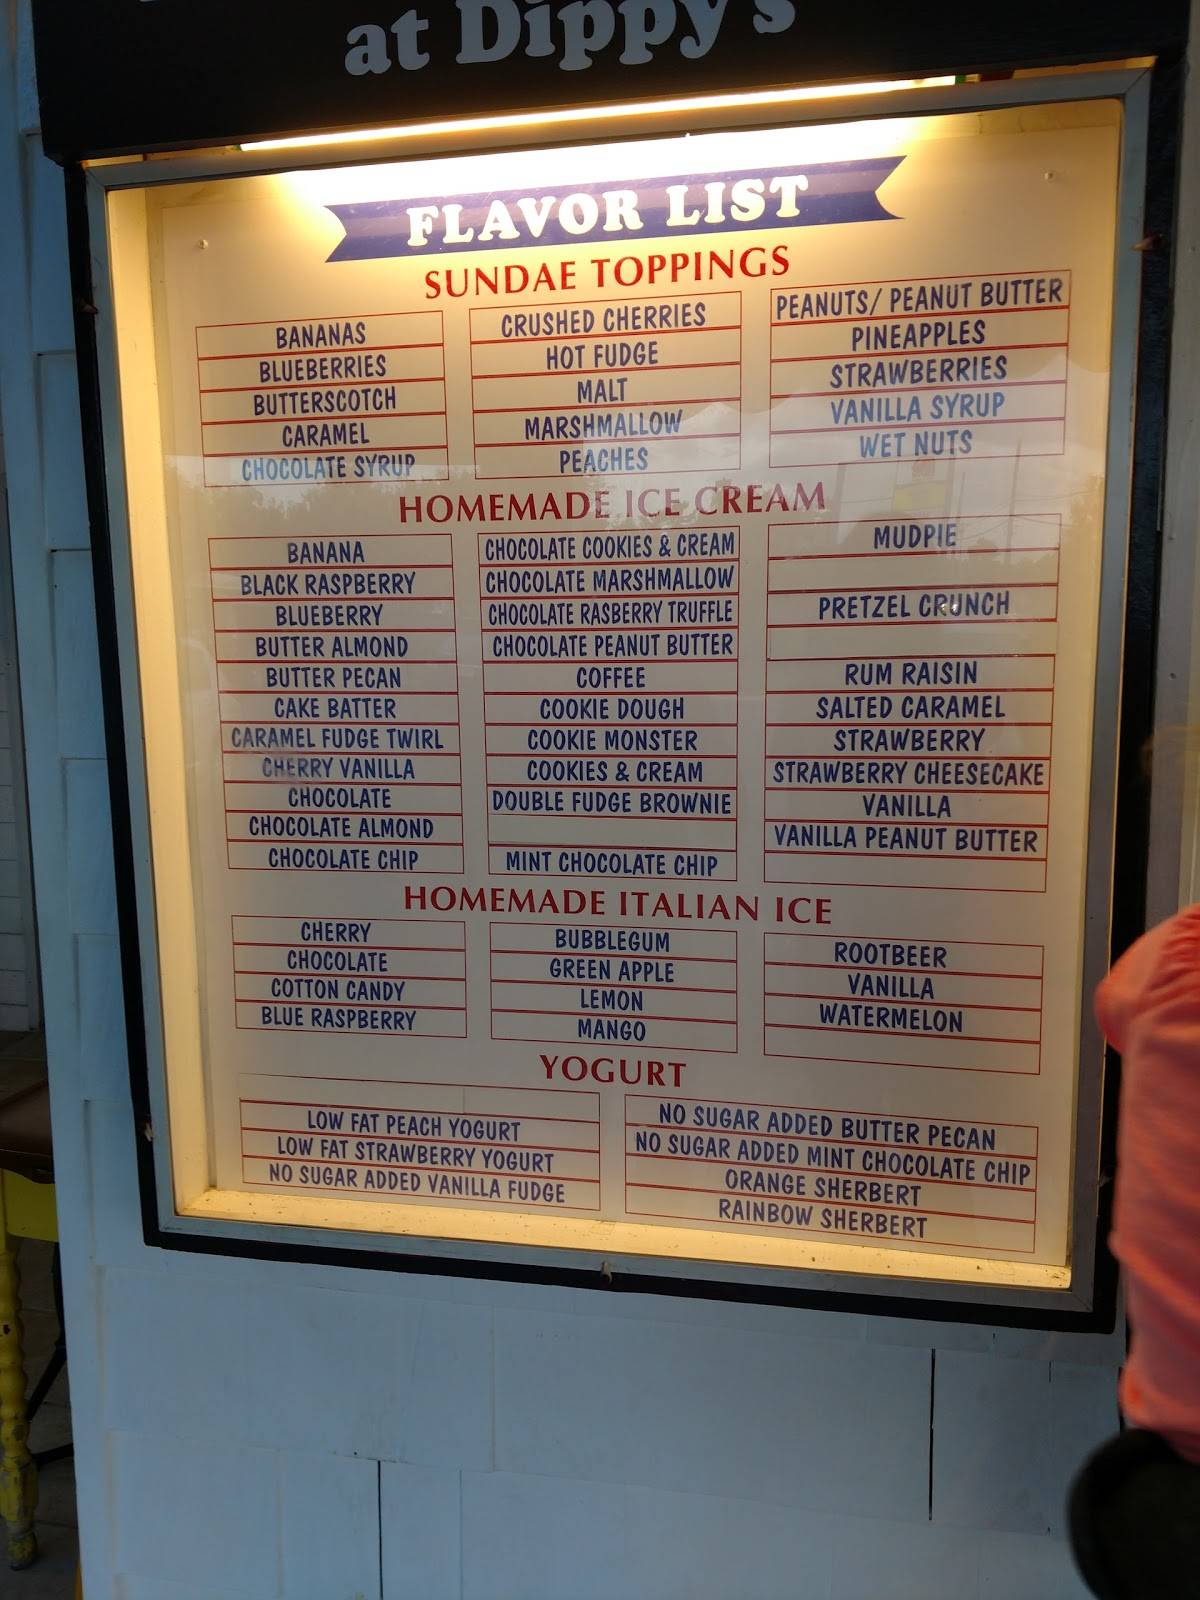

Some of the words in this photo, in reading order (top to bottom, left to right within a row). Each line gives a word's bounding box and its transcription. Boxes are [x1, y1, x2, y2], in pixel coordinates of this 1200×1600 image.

[344, 9, 431, 77] at
[454, 0, 797, 72] Dippys
[406, 189, 645, 248] FLAVOR
[665, 174, 809, 227] LIST
[424, 260, 577, 300] SUNDAE
[591, 245, 790, 288] TOPPINGS
[776, 288, 882, 321] PEANUTS/
[889, 281, 973, 313] PEANUT
[979, 277, 1063, 308] BUTTER
[500, 308, 596, 338] CRUSHED
[603, 301, 706, 332] CHERRIES
[275, 321, 367, 350] BANANAS
[851, 319, 987, 352] PINEAPPLES
[258, 354, 388, 384] BLUEBERRIES
[546, 344, 585, 371] HOT
[593, 340, 659, 368] FUDGE
[829, 354, 1008, 389] STRAWBERRIES
[252, 385, 397, 417] BUTTERSCOTCH
[576, 377, 629, 404] MALT
[830, 395, 922, 426] VANILLA
[929, 391, 1007, 420] SYRUP
[281, 422, 370, 448] CARAMEL
[524, 408, 684, 442] MARSHMALLOW
[858, 432, 907, 459] WET
[913, 429, 973, 457] NUTS
[241, 455, 346, 482] CHOCOLATE
[353, 453, 416, 480] SYRUP
[559, 446, 650, 475] PEACHES
[399, 490, 611, 523] HOMEMADE
[625, 486, 681, 518] ICE
[694, 480, 826, 516] CREAM
[484, 536, 576, 561] CHOCOLATE
[581, 533, 654, 561] COOKIES
[658, 537, 672, 557] &
[676, 531, 735, 557] CREAM
[873, 522, 958, 550] MUDPIE
[287, 541, 366, 565] BANANA
[240, 573, 299, 597] BLACK
[304, 570, 417, 596] RASPBERRY
[485, 568, 586, 594] CHOCOLATE
[592, 565, 736, 593] MARSHMALLOW
[274, 603, 384, 627] BLUEBERRY
[487, 602, 575, 626] CHOCOLATE
[579, 600, 664, 626] RASBERRY
[667, 599, 734, 624] TRUFFLE
[818, 594, 911, 620] PRETZEL
[918, 590, 1011, 617] CRUNCH
[254, 635, 325, 658] BUTTER
[331, 634, 410, 658] ALMOND
[492, 633, 588, 658] CHOCOLATE
[593, 634, 661, 657] PEANUT
[666, 632, 734, 657] BUTTER
[265, 666, 336, 689] BUTTER
[342, 665, 402, 689] PECAN
[575, 666, 647, 690] COFFEE
[844, 662, 893, 686] RUM
[901, 660, 979, 686] RAISIN
[273, 697, 321, 720] CAKE
[327, 697, 397, 720] BATTER
[539, 697, 610, 720] COOKIE
[616, 696, 686, 720] DOUGH
[815, 696, 893, 720] SALTED
[900, 694, 1006, 719] CARAMEL
[231, 727, 317, 750] CARAMEL
[321, 727, 380, 750] FUDGE
[386, 727, 445, 751] TWIRL
[526, 728, 598, 751] COOKIE
[603, 728, 698, 753] MONSTER
[832, 727, 986, 753] STRAWBERRY
[261, 757, 334, 779] CHERRY
[338, 757, 416, 781] VANILLA
[526, 759, 609, 782] COOKIES
[614, 760, 631, 783] &
[636, 760, 704, 784] CREAM
[772, 760, 908, 786] STRAWBERRY
[913, 761, 1045, 787] CHEESECAKE
[287, 786, 392, 809] CHOCOLATE
[491, 790, 565, 812] DOUBLE
[571, 791, 632, 814] FUDGE
[639, 792, 732, 816] BROWNIE
[862, 793, 952, 818] VANILLA
[248, 815, 352, 838] CHOCOLATE
[357, 816, 435, 839] ALMOND
[773, 824, 857, 849] VANILLA
[864, 826, 948, 851] PEANUT
[954, 828, 1039, 854] BUTTER
[267, 846, 371, 870] CHOCOLATE
[377, 847, 420, 871] CHIP
[505, 850, 552, 873] MINT
[557, 851, 666, 877] CHOCOLATE
[673, 853, 719, 877] CHIP
[403, 885, 606, 917] HOMEMADE
[619, 891, 759, 922] ITALIAN
[775, 896, 833, 925] ICE
[300, 921, 372, 944] CHERRY
[555, 927, 672, 954] BUBBLEGUM
[286, 950, 389, 973] CHOCOLATE
[834, 941, 948, 969] ROOTBEER
[548, 958, 611, 981] GREEN
[618, 959, 676, 984] APPLE
[271, 977, 339, 1000] COTTON
[345, 979, 406, 1002] CANDY
[580, 988, 644, 1013] LEMON
[847, 973, 936, 1001] VANILLA
[261, 1005, 305, 1027] BLUE
[310, 1007, 418, 1031] RASPBERRY
[577, 1018, 648, 1043] MANGO
[818, 1002, 964, 1033] WATERMELON
[538, 1053, 688, 1088] YOGURT
[307, 1109, 345, 1131] LOW
[350, 1112, 380, 1133] FAT
[386, 1114, 442, 1138] PEACH
[447, 1117, 522, 1143] YOGURT
[658, 1102, 686, 1126] NO
[693, 1105, 760, 1131] SUGAR
[766, 1110, 833, 1138] ADDED
[840, 1116, 921, 1146] BUTTER
[927, 1123, 996, 1151] PECAN
[276, 1135, 314, 1157] LOW
[319, 1138, 349, 1160] FAT
[354, 1141, 477, 1168] STRAWBERRY
[481, 1148, 555, 1174] YOGURT
[635, 1130, 662, 1153] NO
[666, 1133, 731, 1159] SUGAR
[736, 1139, 800, 1165] ADDED
[806, 1144, 856, 1171] MINT
[861, 1149, 976, 1181] CHOCOLATE
[983, 1160, 1032, 1187] CHIP
[268, 1163, 294, 1183] NO
[298, 1165, 358, 1189] SUGAR
[363, 1170, 421, 1193] ADDED
[426, 1175, 501, 1200] VANILLA
[507, 1180, 566, 1204] FUDGE
[724, 1168, 807, 1196] ORANGE
[813, 1175, 922, 1207] SHERBERT
[718, 1197, 814, 1227] RAINBOW
[819, 1208, 928, 1239] SHERBERT
